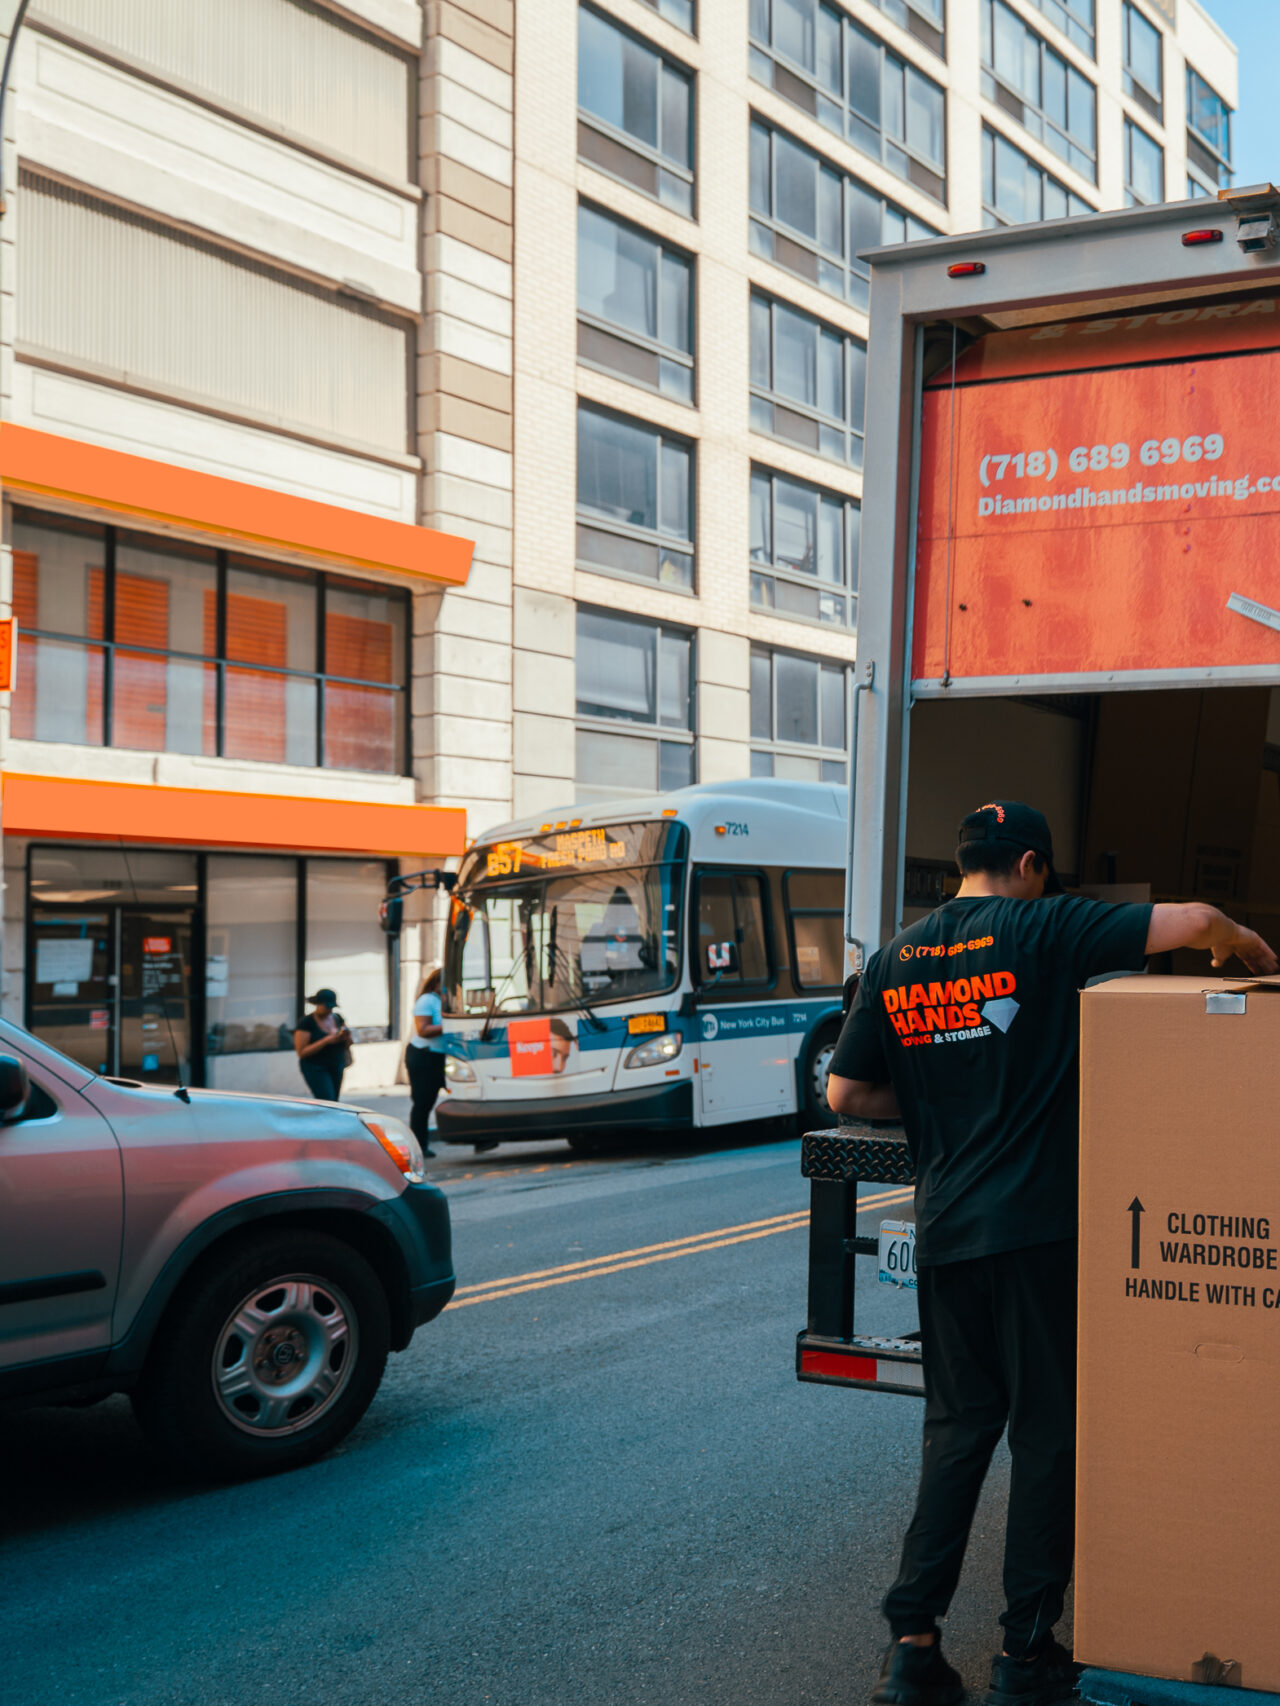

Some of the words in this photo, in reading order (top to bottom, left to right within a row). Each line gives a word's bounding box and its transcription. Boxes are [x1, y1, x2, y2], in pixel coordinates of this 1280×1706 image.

[1029, 323, 1068, 340] &
[979, 448, 1058, 487] (718)
[1068, 442, 1130, 472] 689
[1139, 434, 1224, 466] 6969
[725, 822, 749, 836] 7214
[487, 841, 523, 876] B57
[915, 944, 946, 959] (718)
[882, 971, 1017, 1014] DIAMOND
[720, 1019, 736, 1031] New
[737, 1017, 754, 1029] York
[755, 1016, 770, 1029] City
[771, 1015, 785, 1027] Bus
[889, 1003, 982, 1036] HANDS
[934, 1033, 945, 1044] &
[945, 1025, 992, 1043] STORAGE
[1167, 1212, 1270, 1240] CLOTHING
[1160, 1241, 1278, 1270] WARDROBE
[1125, 1277, 1200, 1302] HANDLE
[1206, 1283, 1255, 1307] WITH
